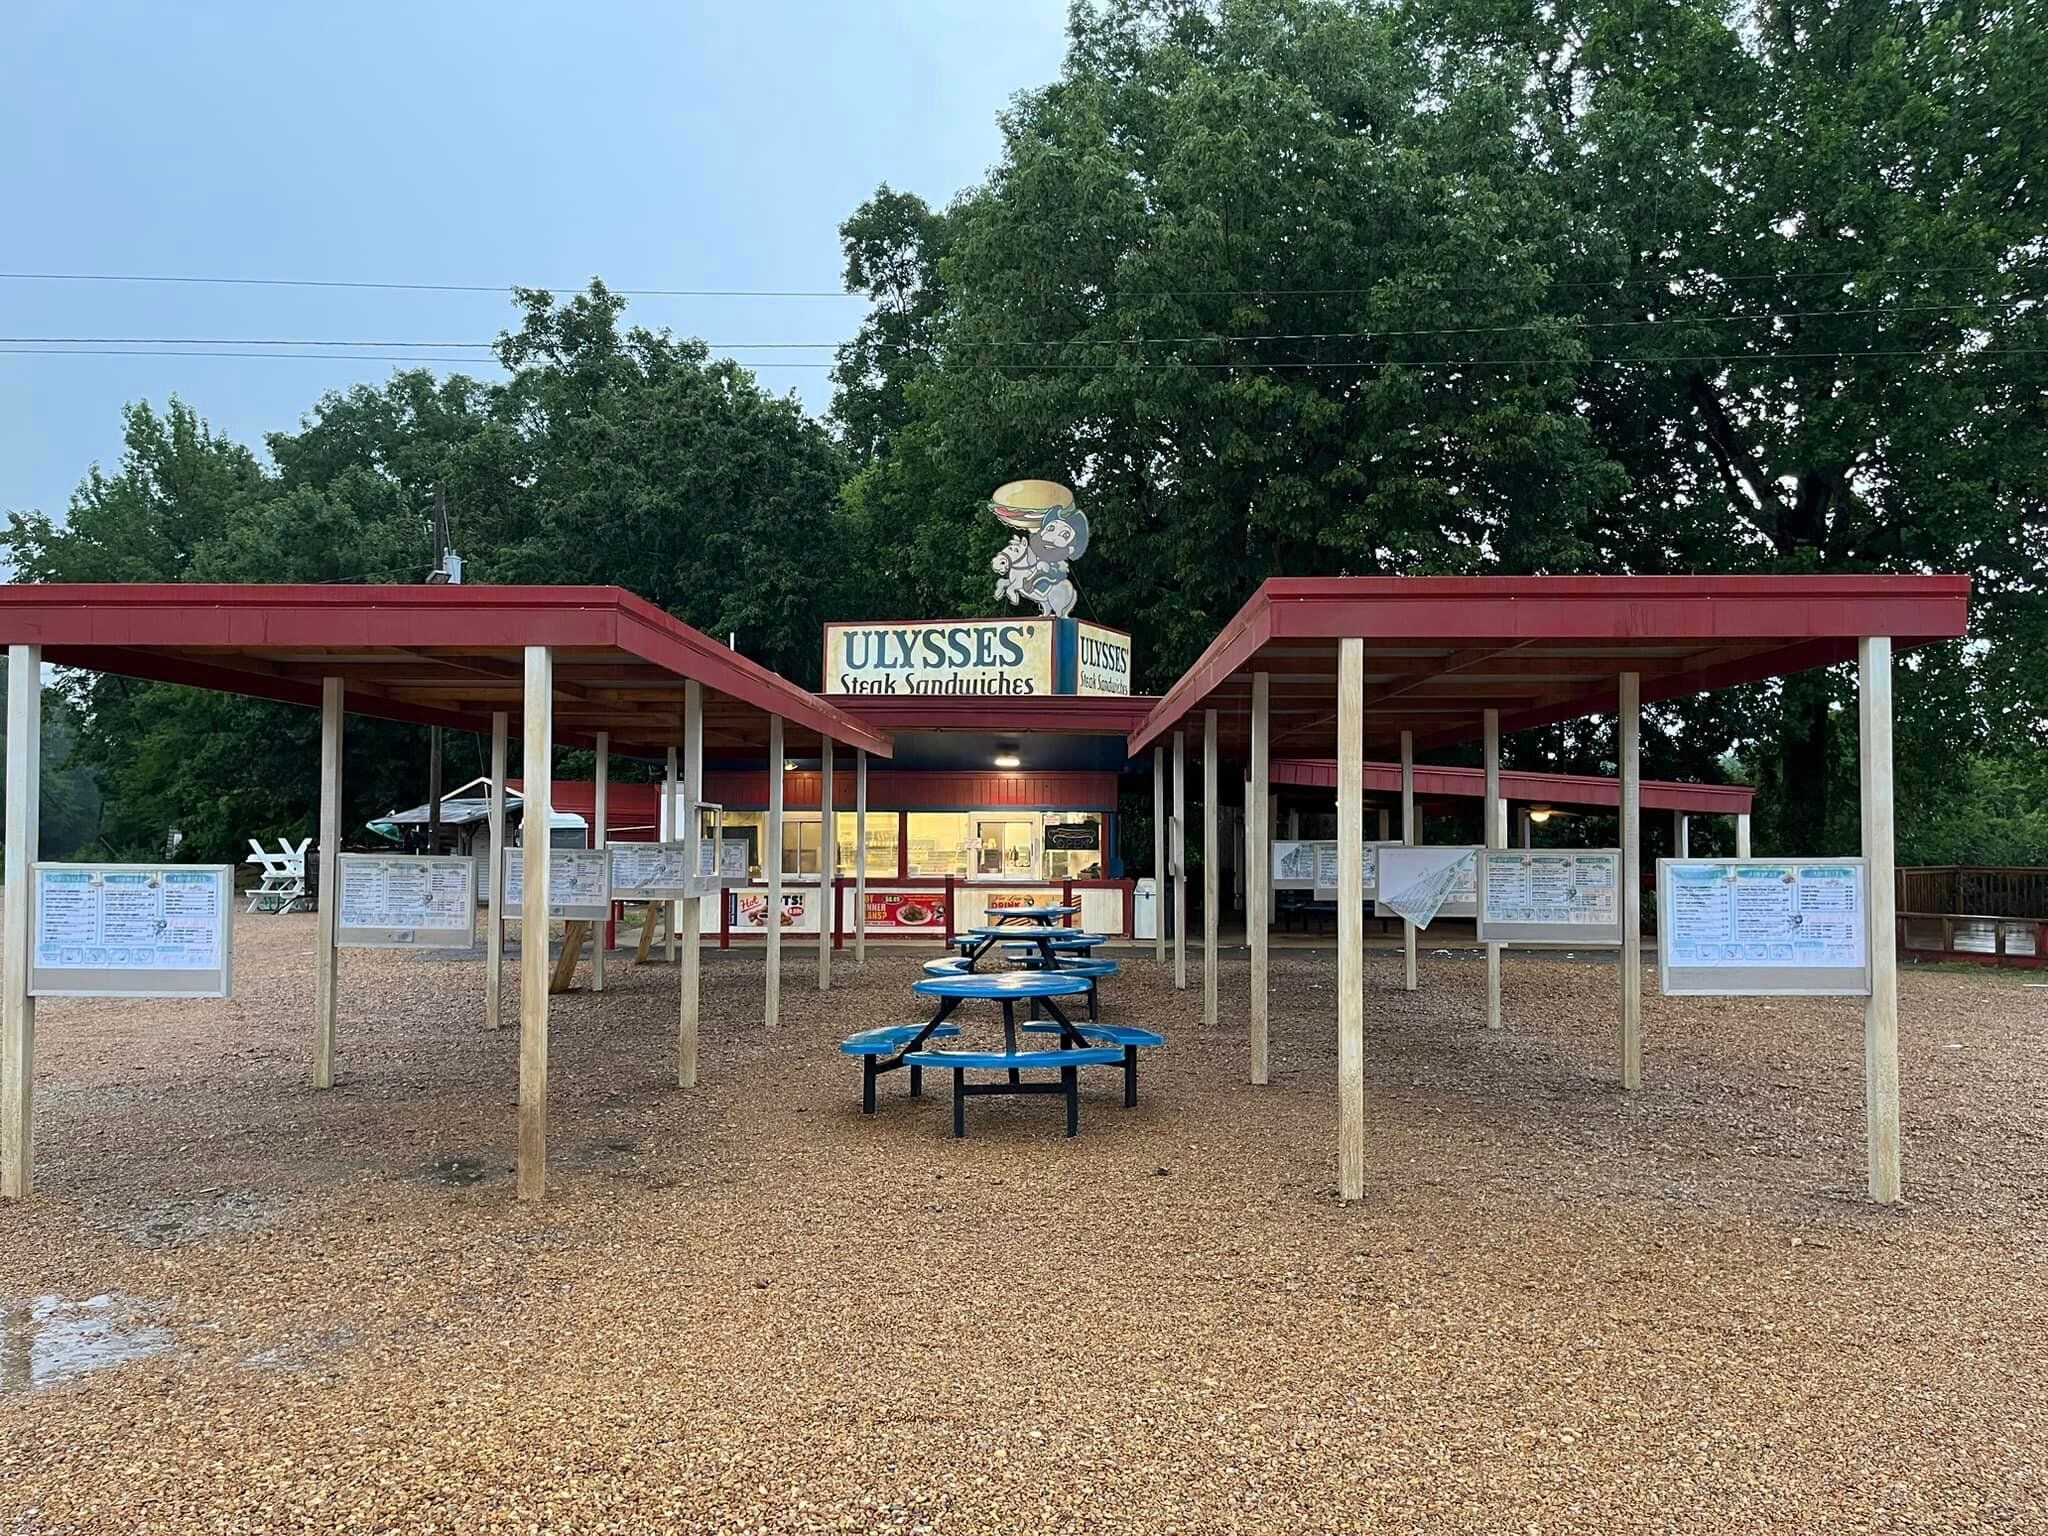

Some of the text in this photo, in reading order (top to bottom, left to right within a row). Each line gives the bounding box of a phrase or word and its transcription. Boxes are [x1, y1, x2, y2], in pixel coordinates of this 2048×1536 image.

[843, 626, 1035, 670] ULYSSES'
[840, 671, 1035, 695] Steak Sandwiches
[1057, 839, 1090, 849] OPEN
[741, 895, 760, 909] Hot
